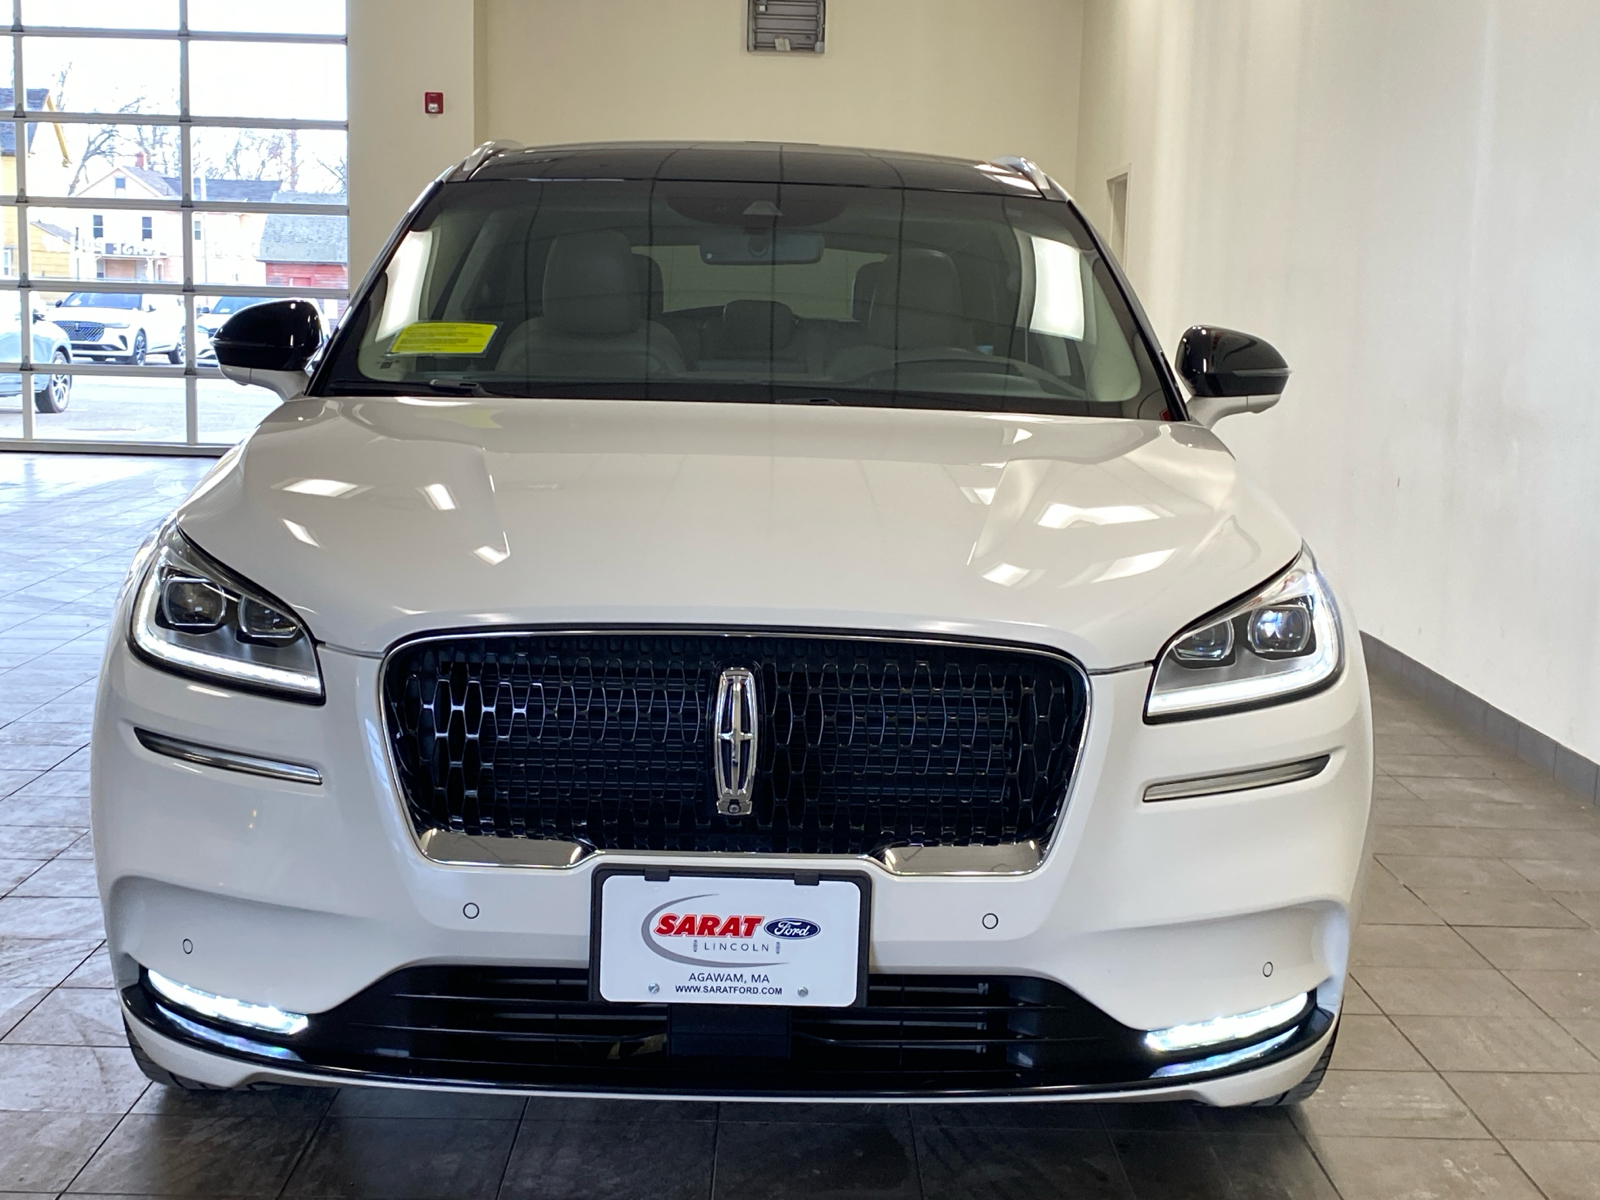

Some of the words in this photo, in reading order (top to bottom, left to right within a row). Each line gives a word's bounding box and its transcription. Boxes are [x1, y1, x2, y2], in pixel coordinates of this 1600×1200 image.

[654, 913, 764, 938] SARAT
[773, 920, 811, 938] Ford
[704, 942, 769, 952] LINCOLN
[688, 973, 747, 984] AGAWAM,
[751, 974, 770, 984] MA
[675, 985, 783, 995] WWW.SARATFORD.COM
